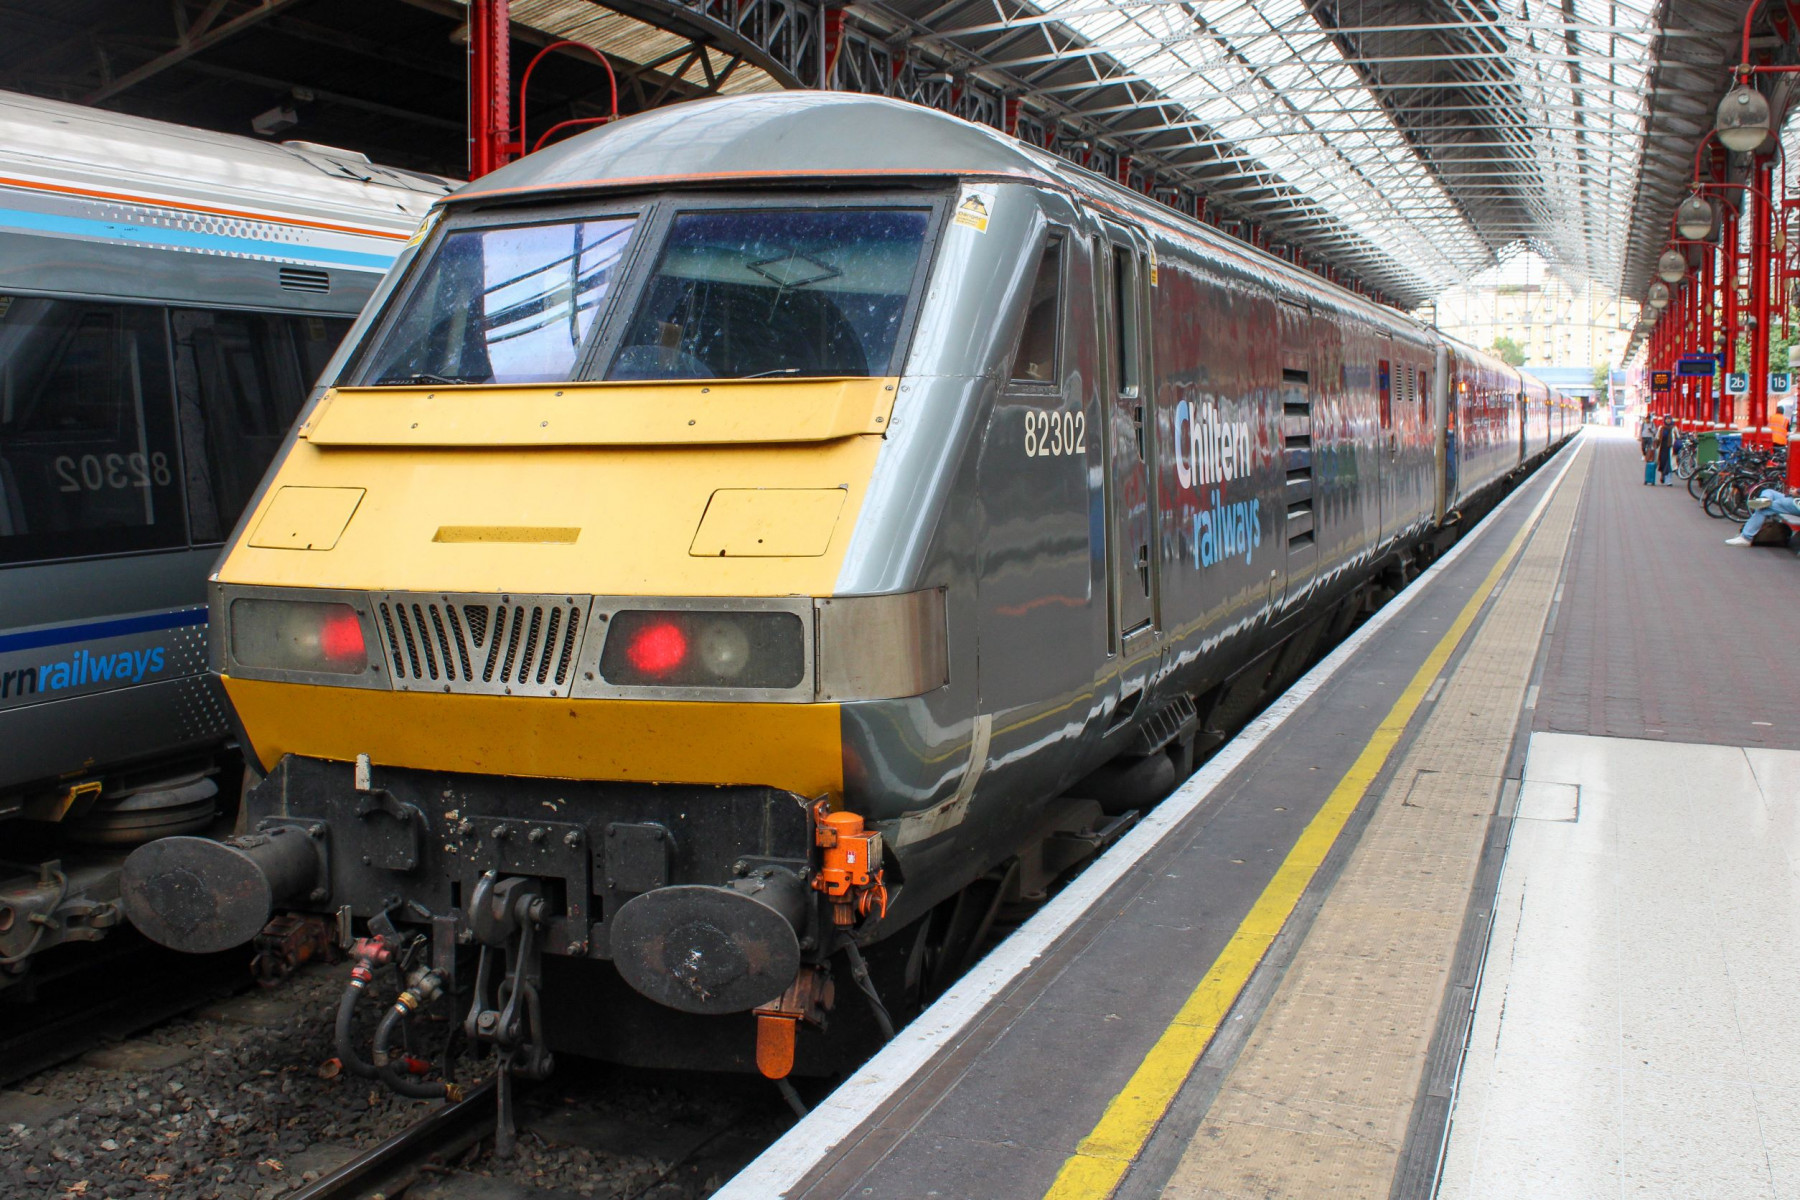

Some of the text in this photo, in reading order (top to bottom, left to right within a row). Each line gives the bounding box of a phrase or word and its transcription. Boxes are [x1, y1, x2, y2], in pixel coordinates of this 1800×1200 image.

[1731, 377, 1745, 388] 2b
[1773, 377, 1786, 388] 1b
[1025, 411, 1086, 457] 82302
[1175, 400, 1251, 489] Chiltern
[1193, 489, 1261, 570] railways
